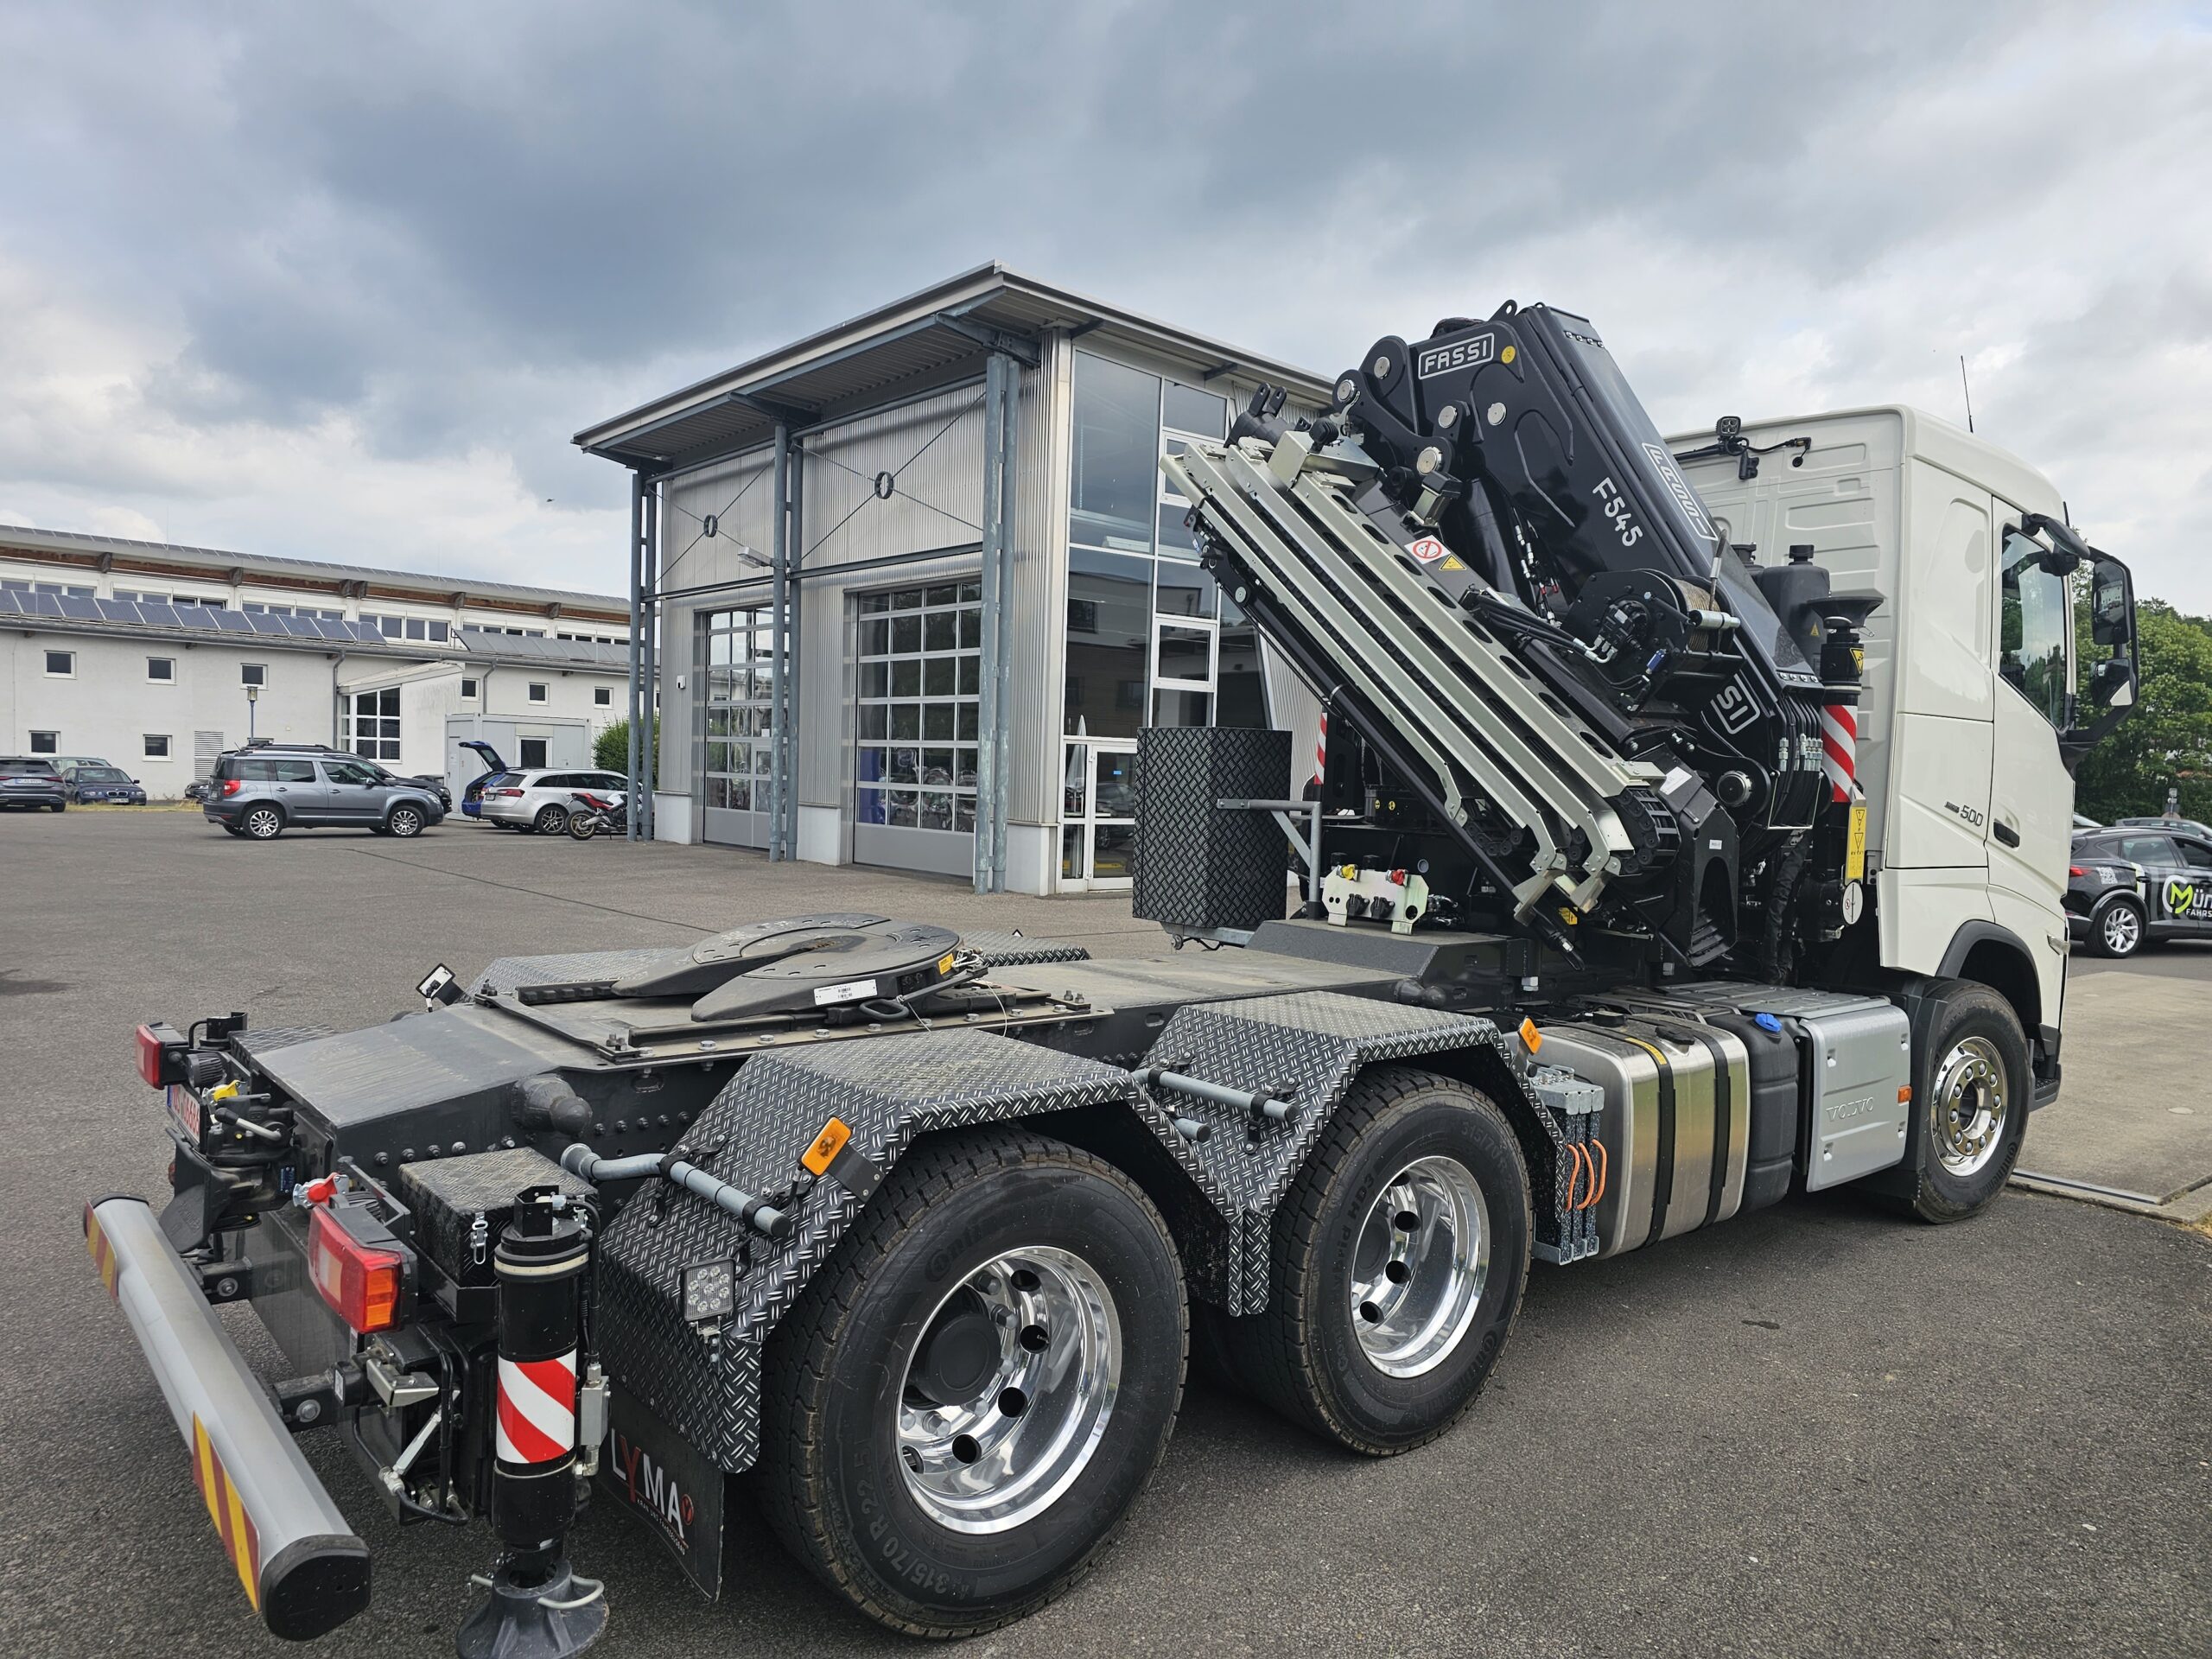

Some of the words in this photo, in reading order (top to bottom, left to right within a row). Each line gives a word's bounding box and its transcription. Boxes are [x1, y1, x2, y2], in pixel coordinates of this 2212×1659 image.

[1424, 340, 1487, 373] FASSI
[1592, 477, 1643, 547] F545
[1649, 448, 1708, 534] FASSI
[1960, 804, 1984, 827] 500
[1825, 1096, 1874, 1122] VOLVO
[1349, 1173, 1376, 1220] HD3
[611, 1427, 684, 1540] LYMA
[869, 1514, 891, 1542] R
[883, 1536, 952, 1595] 315/70
